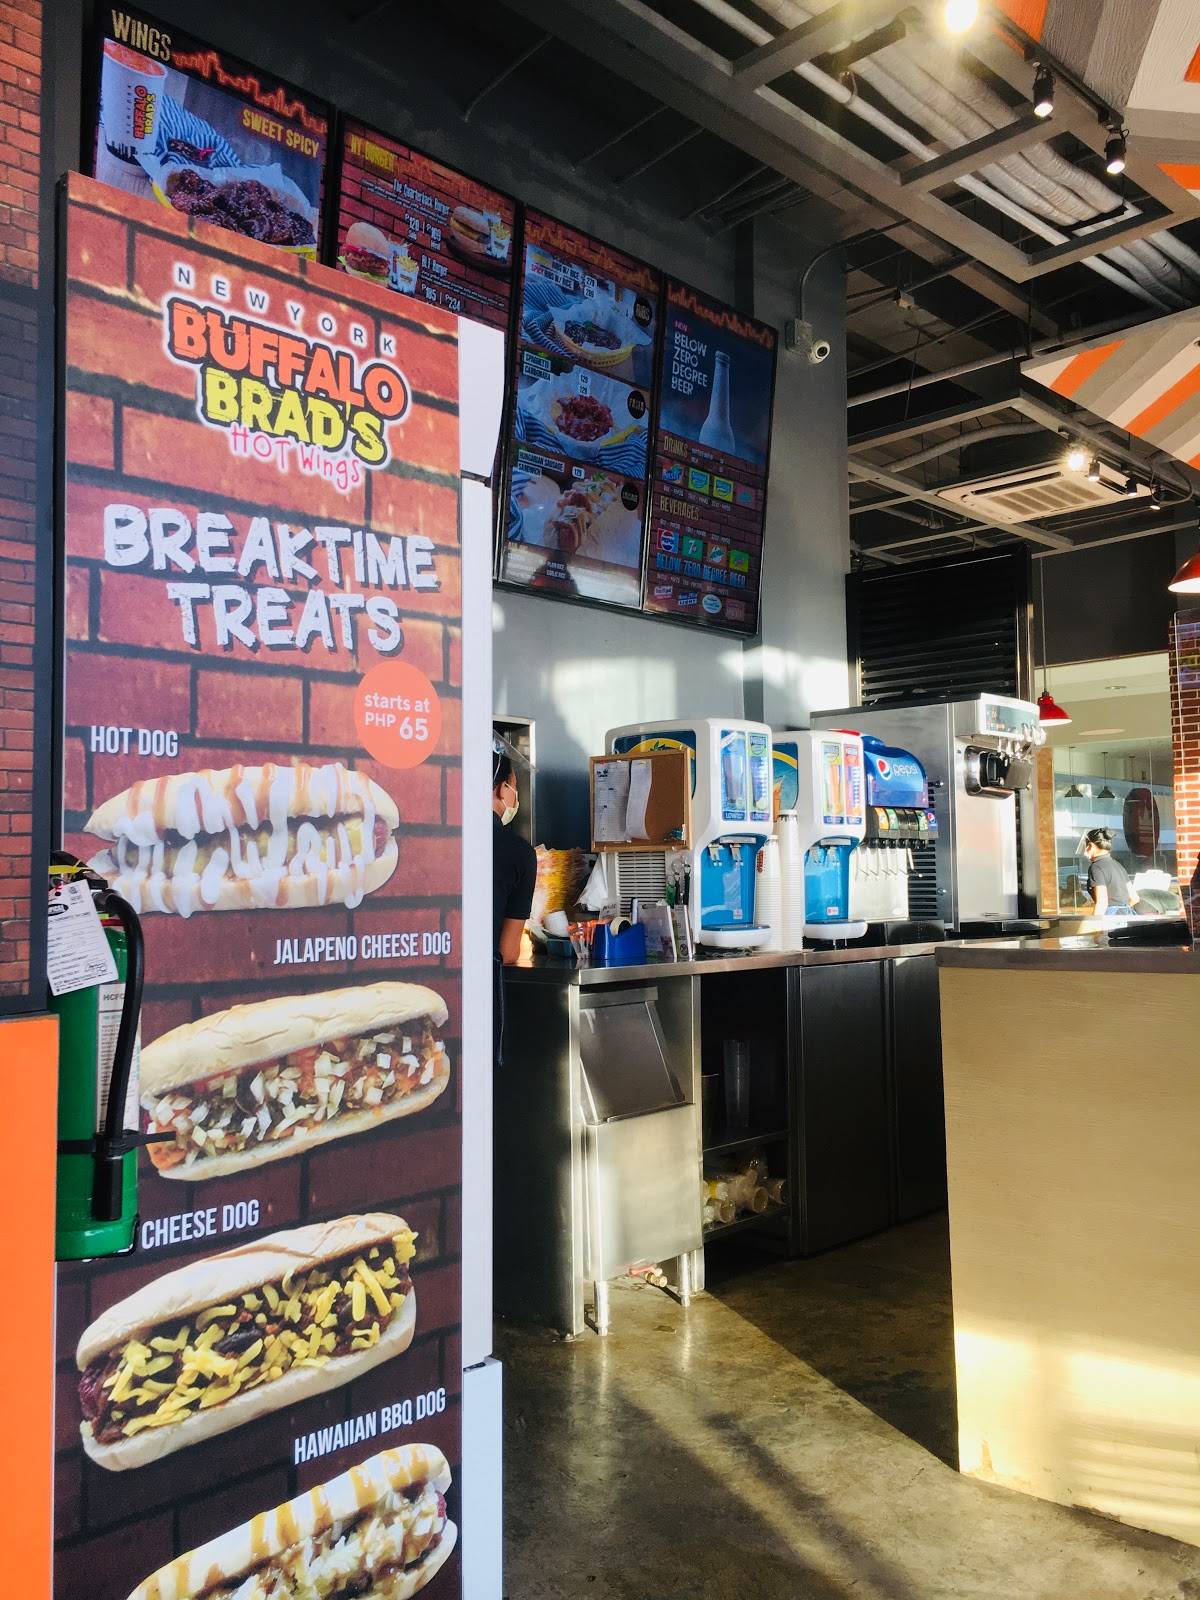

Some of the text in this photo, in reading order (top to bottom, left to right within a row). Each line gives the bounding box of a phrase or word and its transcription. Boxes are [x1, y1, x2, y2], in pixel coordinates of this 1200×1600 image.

[111, 9, 172, 62] WINGS
[242, 108, 319, 158] SWEET SPICY
[170, 299, 409, 418] BUFFALO
[673, 346, 699, 368] ZERO
[675, 333, 707, 357] BELOW
[671, 376, 694, 396] BEER
[672, 360, 709, 387] DEGREE
[203, 367, 387, 463] BRAD'S
[231, 428, 292, 470] HOT
[659, 495, 700, 521] BEVERAGES
[103, 503, 440, 591] BREAKTIME
[656, 552, 682, 573] BELOW
[166, 582, 403, 653] TREATS
[364, 691, 430, 713] starts at
[90, 724, 180, 758] HOT DOG
[364, 712, 430, 741] PHP 65
[892, 763, 919, 778] pepsi
[273, 931, 452, 966] JALAPENO CHEESE DOG
[141, 1198, 260, 1251] CHEESE DOG
[293, 1387, 447, 1466] HAWAIIAN BBQ DOG
